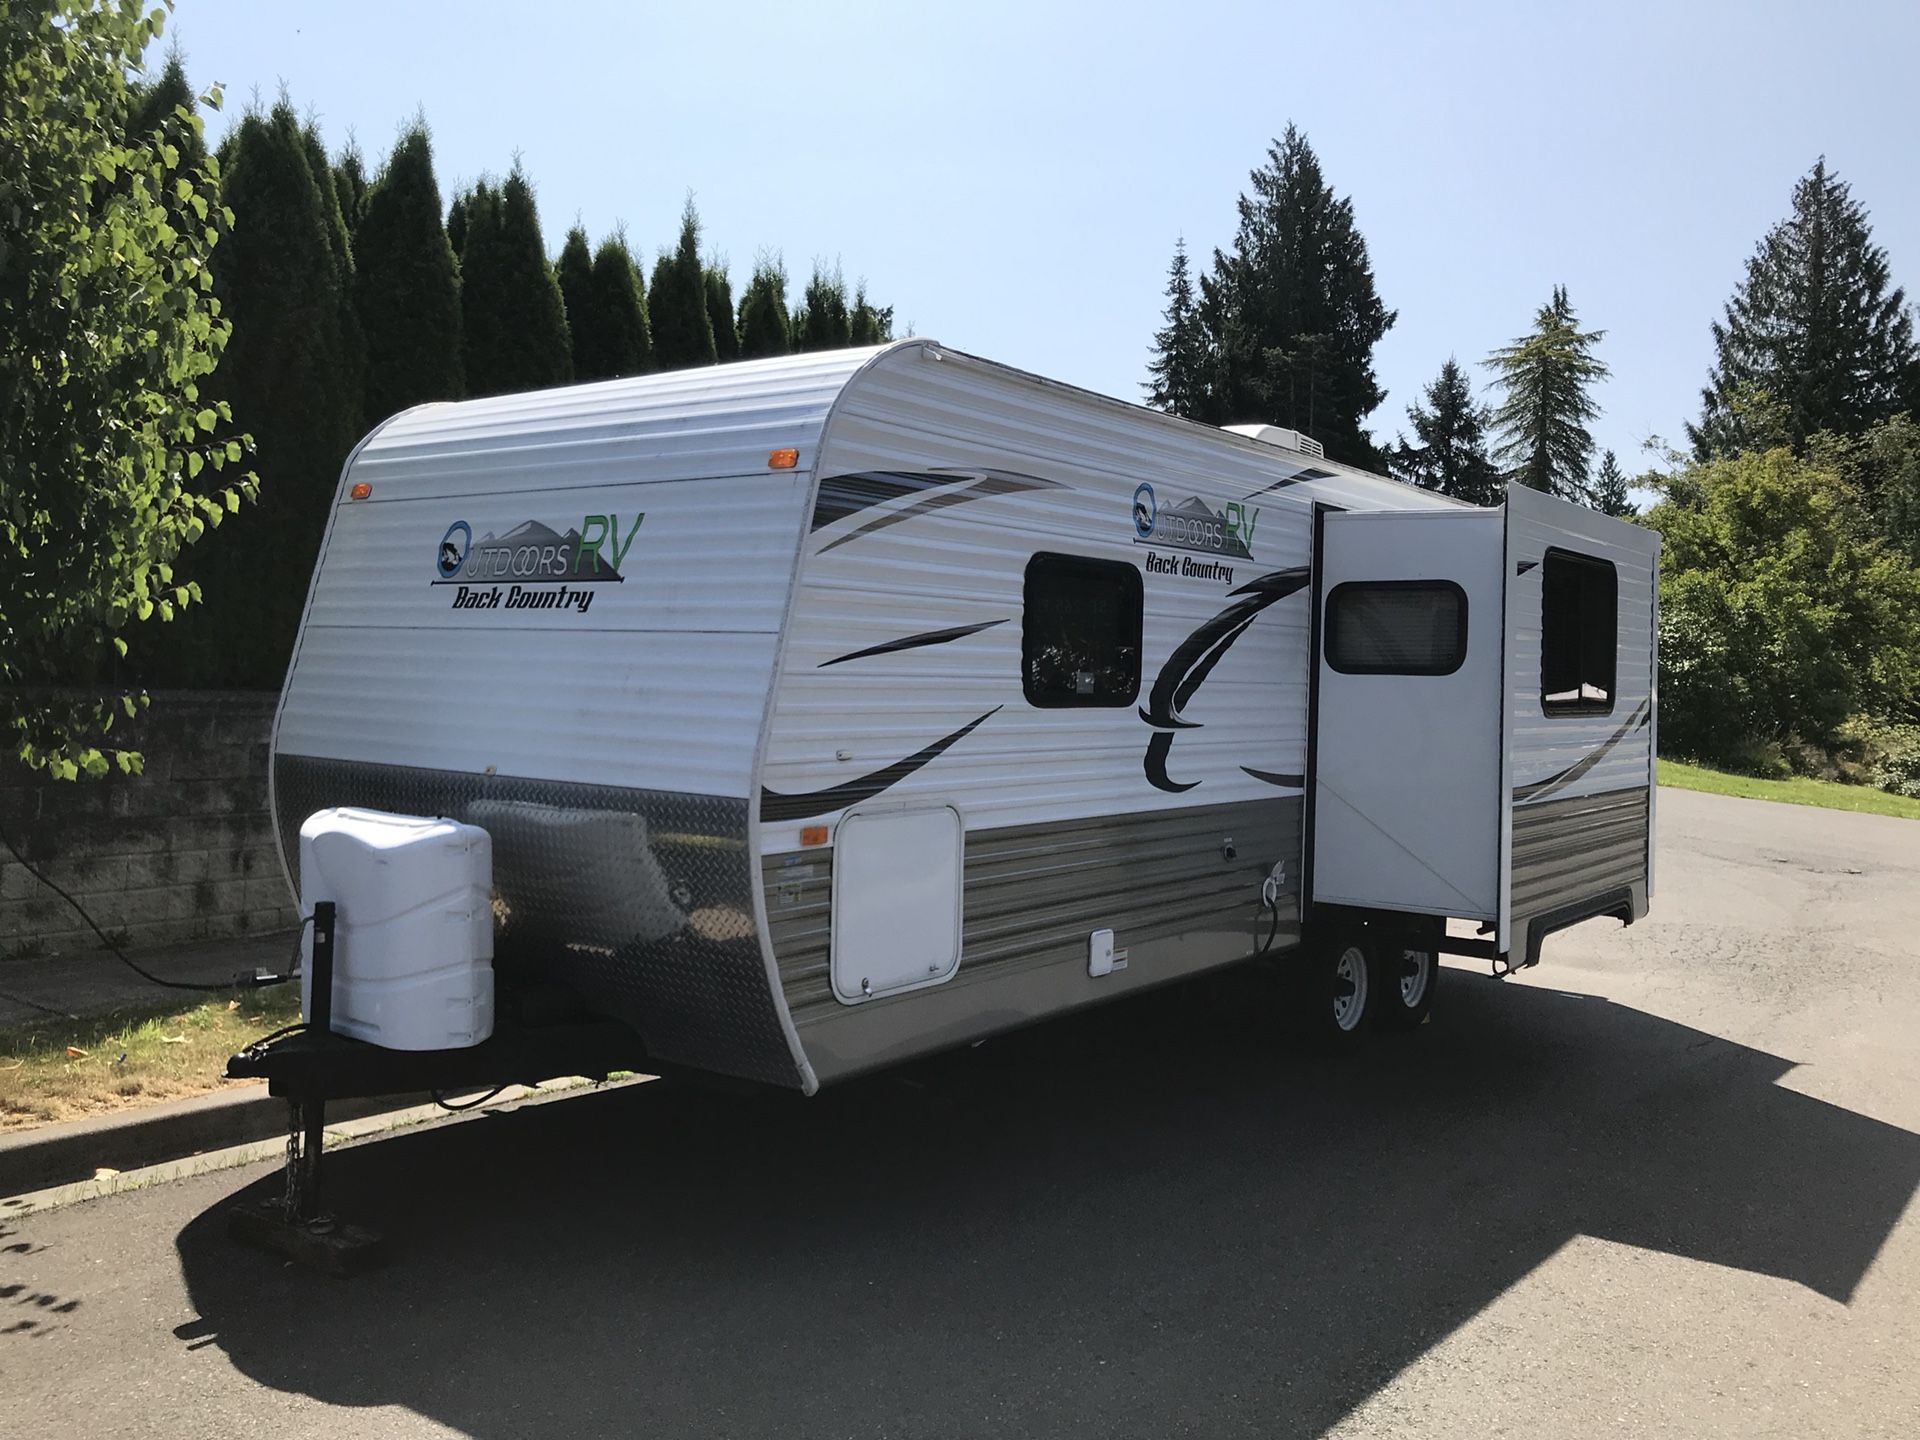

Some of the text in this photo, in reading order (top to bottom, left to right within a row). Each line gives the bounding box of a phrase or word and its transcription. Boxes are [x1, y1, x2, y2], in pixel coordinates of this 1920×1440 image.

[1132, 482, 1260, 551] OUTDOORS RV
[437, 512, 645, 578] OUTDOORS RV
[1145, 551, 1234, 585] Back Country
[452, 585, 595, 613] Back Country
